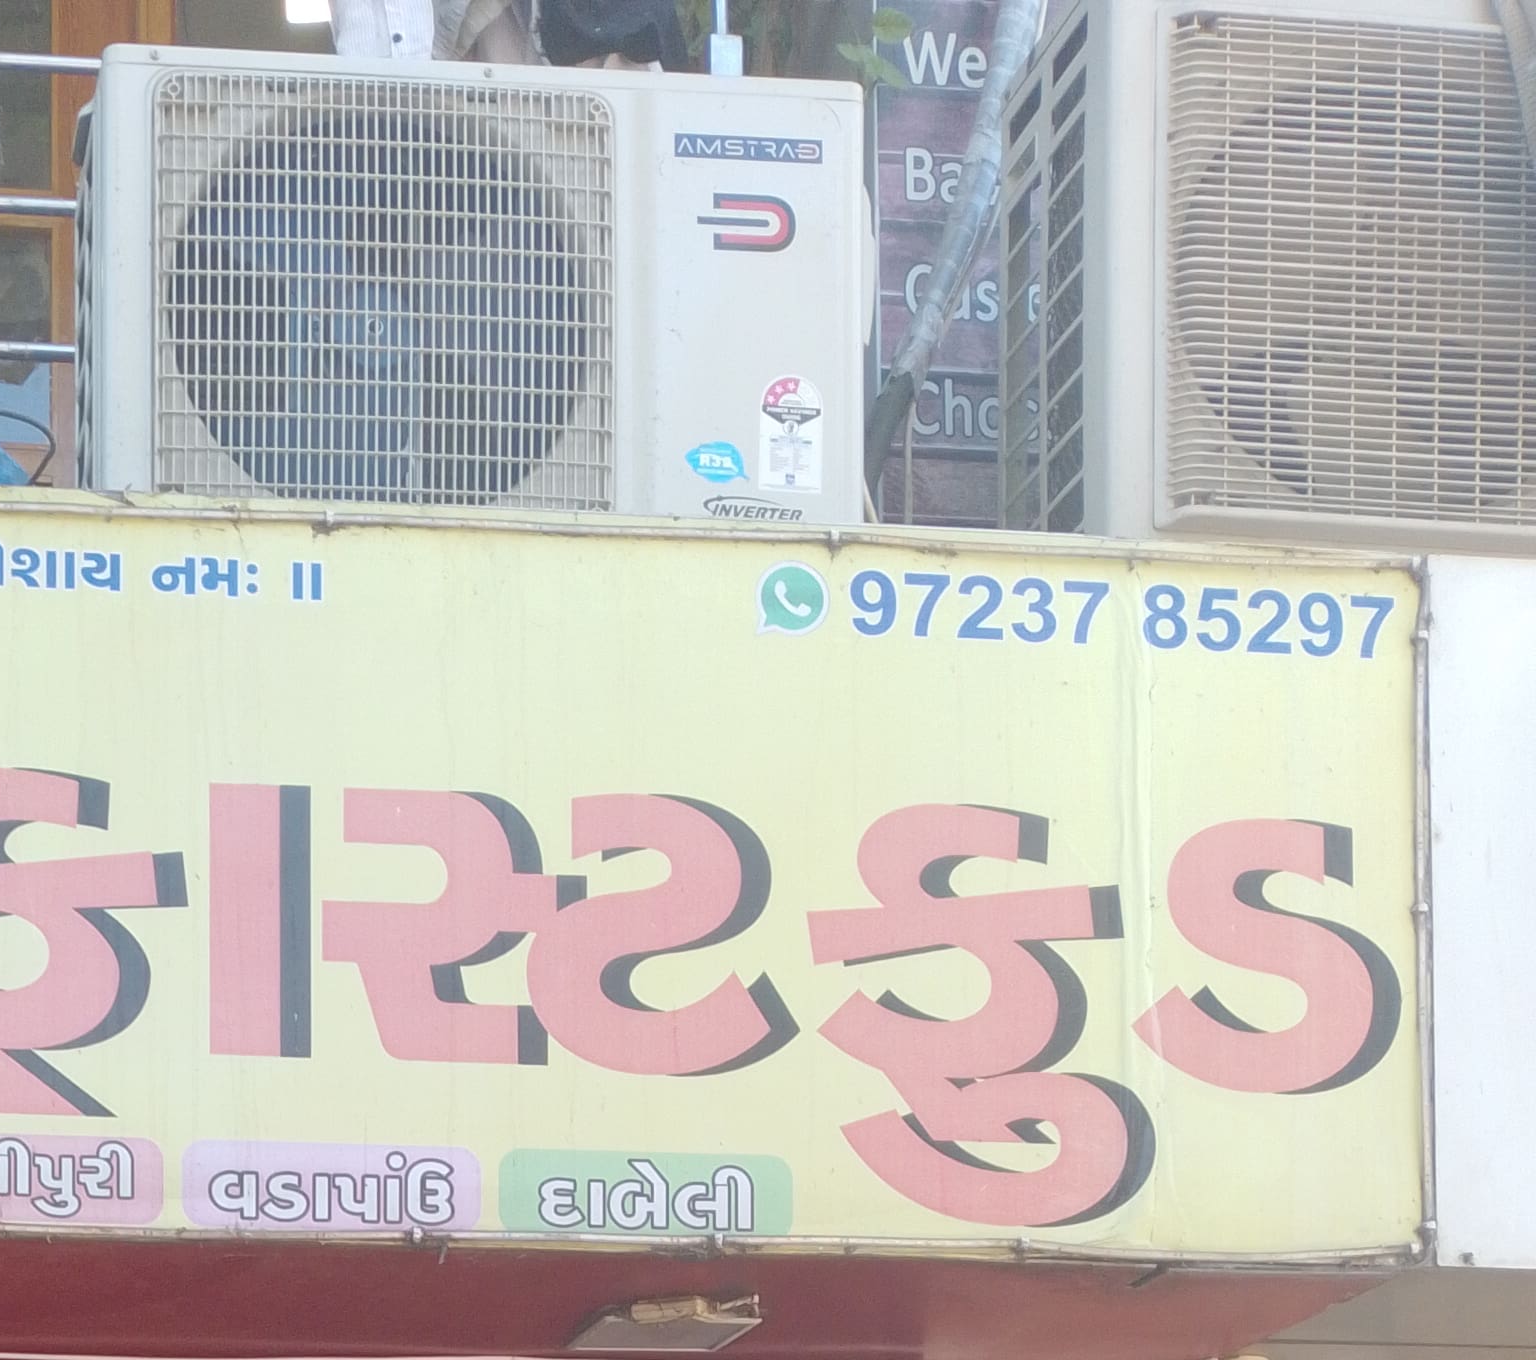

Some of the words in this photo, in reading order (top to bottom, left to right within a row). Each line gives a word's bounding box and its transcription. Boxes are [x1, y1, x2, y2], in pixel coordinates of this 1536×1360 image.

[677, 137, 820, 160] AMSTRAD
[713, 503, 803, 521] INVERTER
[848, 570, 1111, 646] 97237
[1143, 584, 1395, 660] 85297
[208, 1151, 456, 1227] વડાપાંઉ
[537, 1158, 755, 1232] દાબેલી
